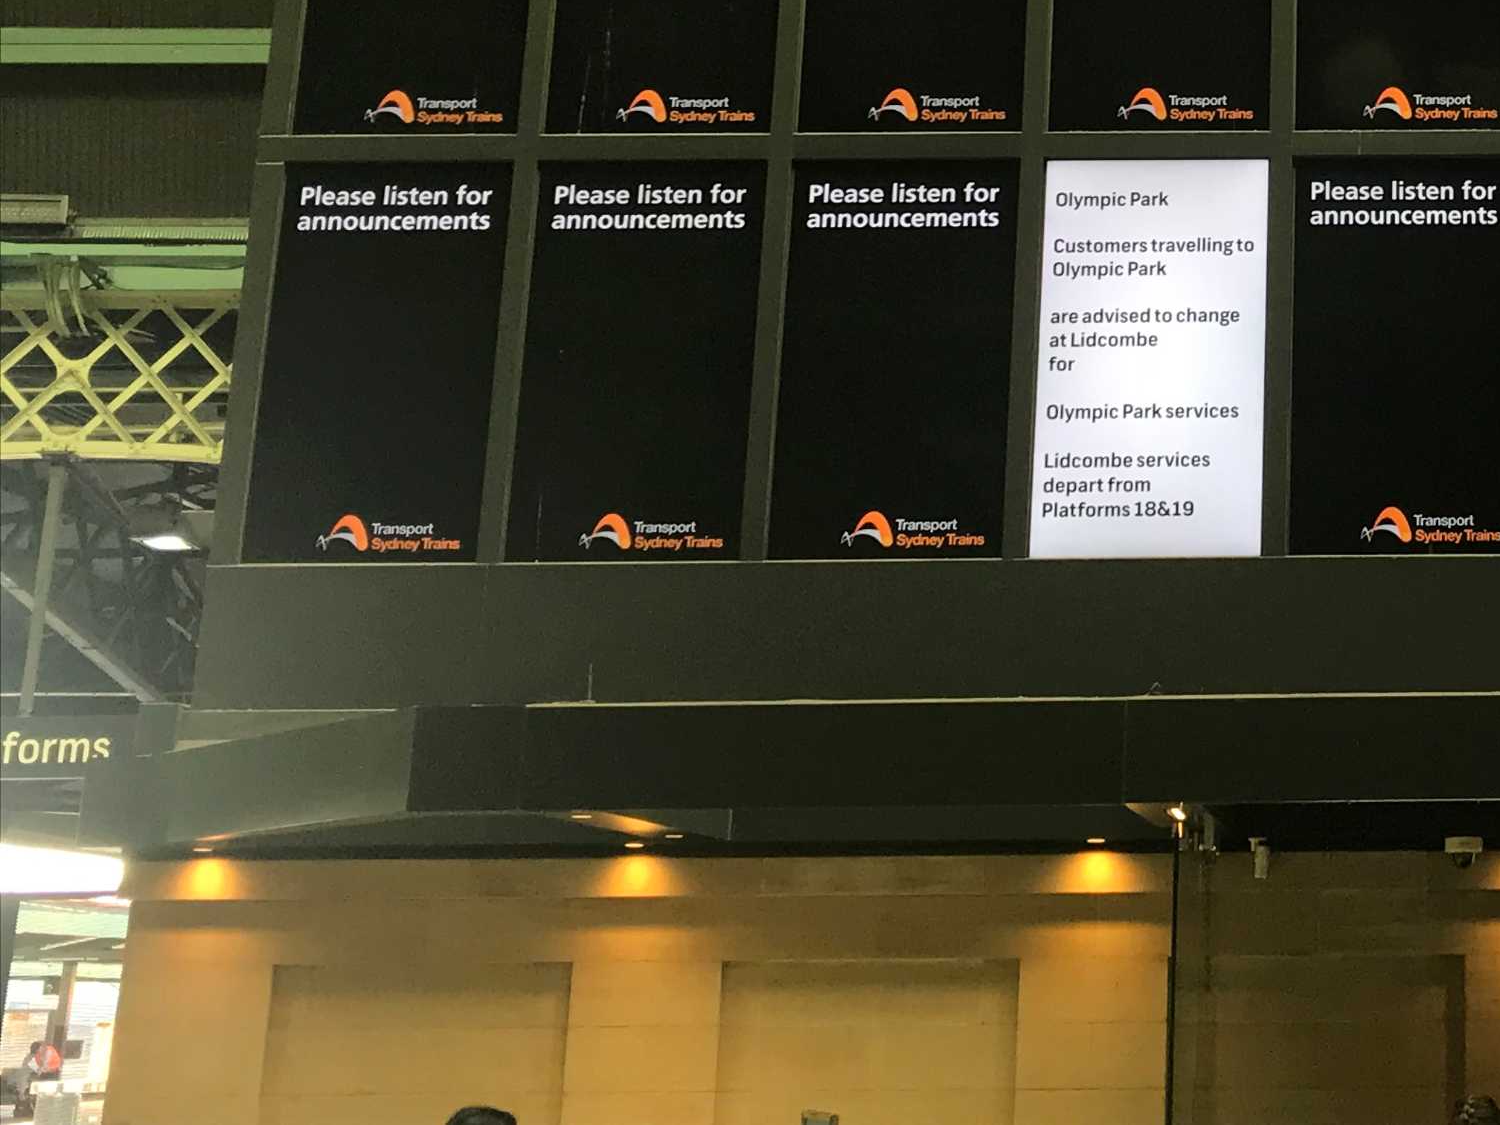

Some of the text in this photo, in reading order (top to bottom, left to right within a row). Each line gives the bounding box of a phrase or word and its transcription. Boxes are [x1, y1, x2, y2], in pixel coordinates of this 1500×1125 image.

[417, 98, 477, 110] Transport
[1413, 94, 1471, 107] Transport
[417, 111, 503, 125] Sydney Trains
[1415, 108, 1498, 121] Sydney Trains
[301, 185, 492, 205] Please listen for
[1056, 192, 1168, 210] Olympic Park
[297, 212, 490, 230] announcements
[1054, 237, 1254, 255] Customers travelling to
[1053, 261, 1166, 279] Olympic Park
[1051, 308, 1240, 326] are advised to change
[1050, 332, 1158, 347] at Lidcombe
[1049, 356, 1074, 371] for
[1047, 403, 1239, 423] Olympic Park services
[1045, 452, 1210, 468] Lidcombe services
[1044, 477, 1150, 496] depart from
[1042, 501, 1193, 517] Platforms 18&19
[372, 523, 433, 537] Transport
[371, 537, 460, 552] Sydney Trains
[3, 732, 110, 764] forms
